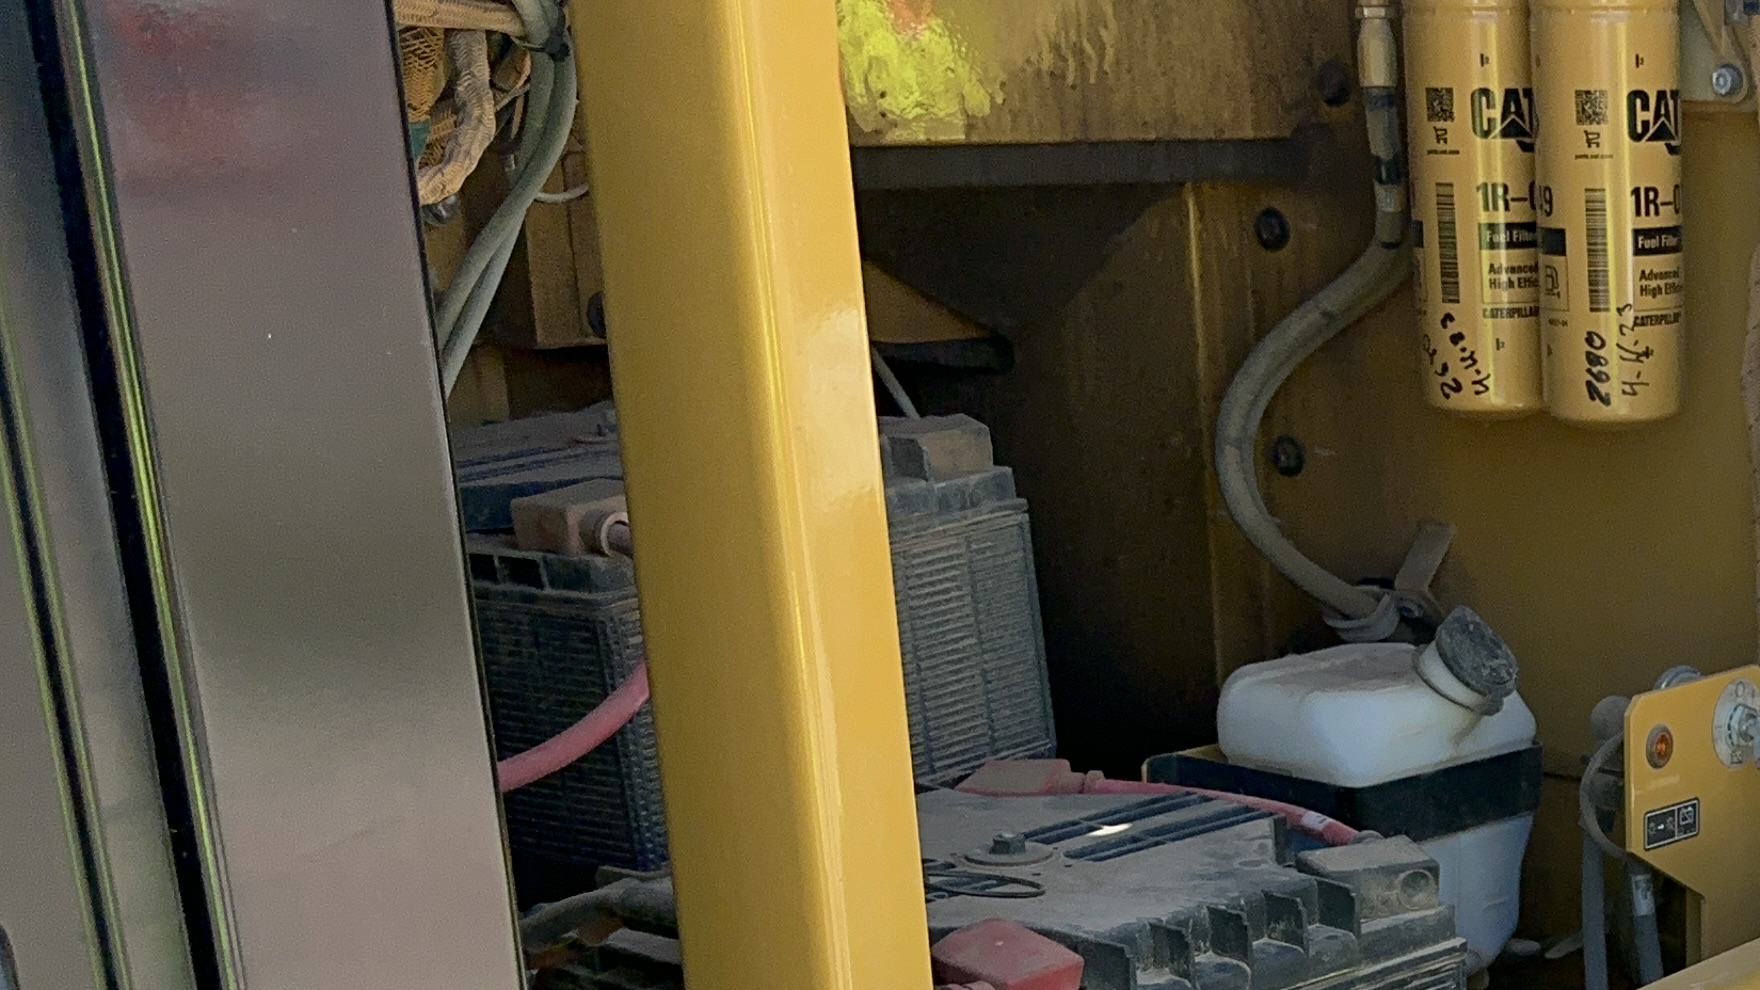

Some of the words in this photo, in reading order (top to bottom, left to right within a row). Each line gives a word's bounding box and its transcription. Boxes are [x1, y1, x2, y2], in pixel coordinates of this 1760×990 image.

[1487, 229, 1510, 242] Fuel
[1638, 235, 1660, 249] Fuel
[1489, 277, 1515, 291] High
[1640, 284, 1663, 299] High
[1585, 331, 1612, 407] 2680
